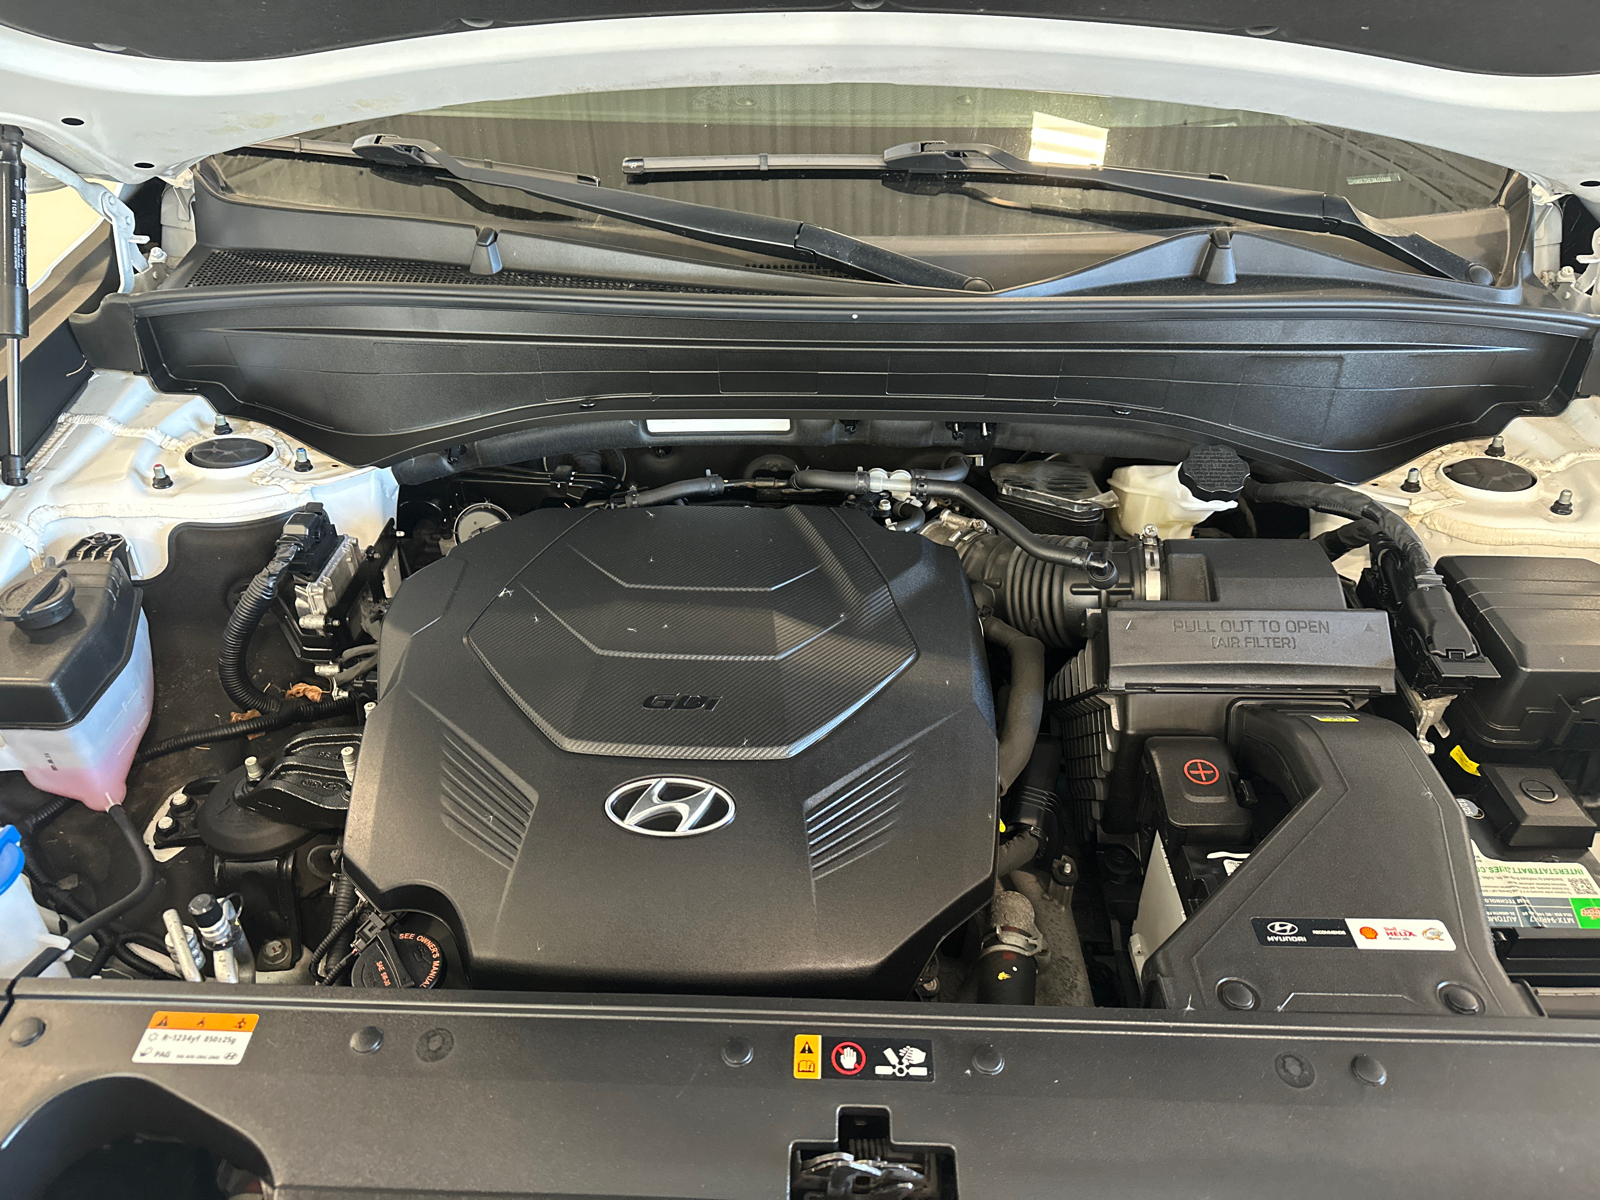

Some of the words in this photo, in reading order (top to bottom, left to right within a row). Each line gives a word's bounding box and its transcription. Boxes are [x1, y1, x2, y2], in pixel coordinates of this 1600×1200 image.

[1172, 619, 1216, 633] PULL
[1220, 619, 1254, 633] OUT
[1258, 620, 1280, 633] TO
[1285, 620, 1330, 634] OPEN
[1245, 637, 1297, 649] FILTER)
[399, 932, 415, 940] SEE
[416, 935, 440, 959] OWNER'S
[419, 960, 440, 988] MANUAL
